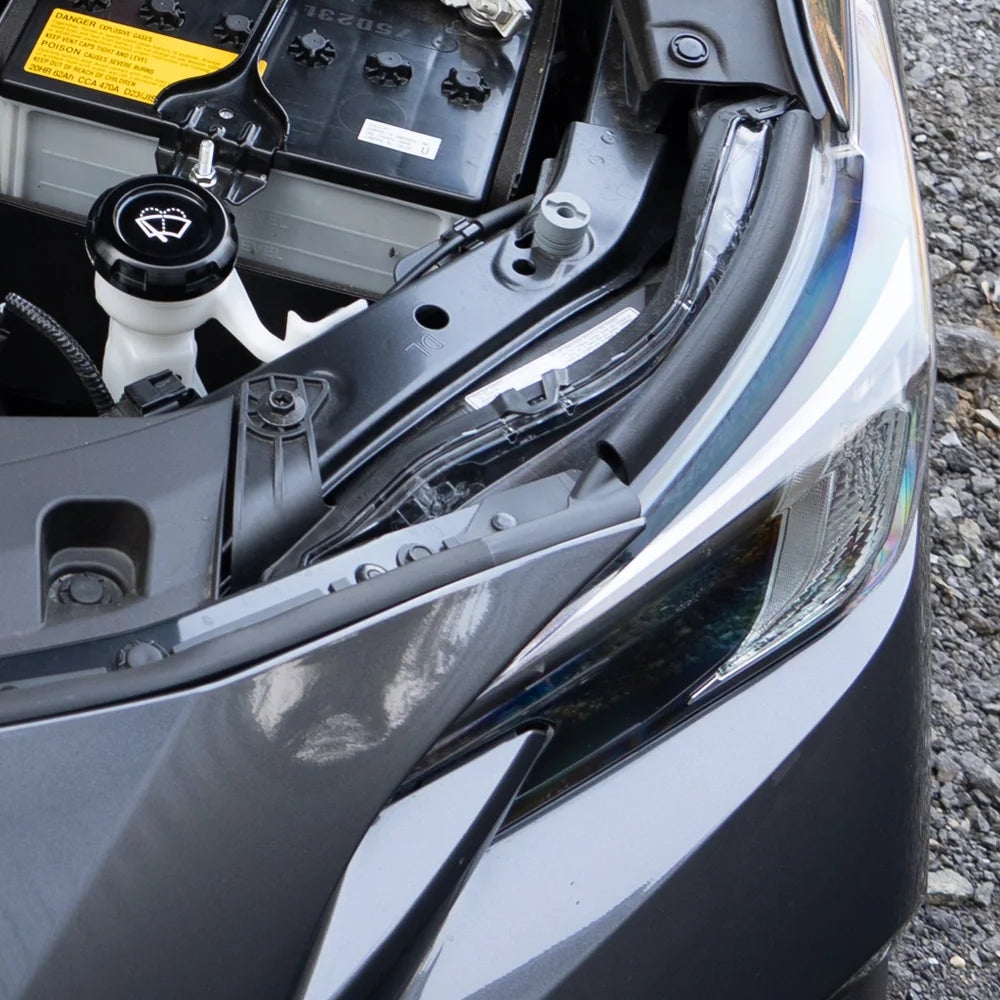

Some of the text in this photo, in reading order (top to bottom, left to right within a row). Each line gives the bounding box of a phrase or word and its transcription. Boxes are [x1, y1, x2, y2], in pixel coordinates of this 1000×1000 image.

[55, 12, 153, 42] DANGER EXPLOSIVE GASES
[40, 40, 154, 75] POISON CAUSES SEVERE BURNS
[45, 32, 148, 64] KEEP VENT CAPS TIGHT AND LEVEL
[28, 64, 52, 75] 20HR
[52, 70, 74, 80] 62Ah
[77, 76, 98, 86] CCA
[100, 81, 120, 92] 470A
[33, 56, 48, 64] KEEP
[50, 60, 62, 68] OUT
[73, 66, 94, 76] REACH
[104, 74, 137, 87] CHILDREN
